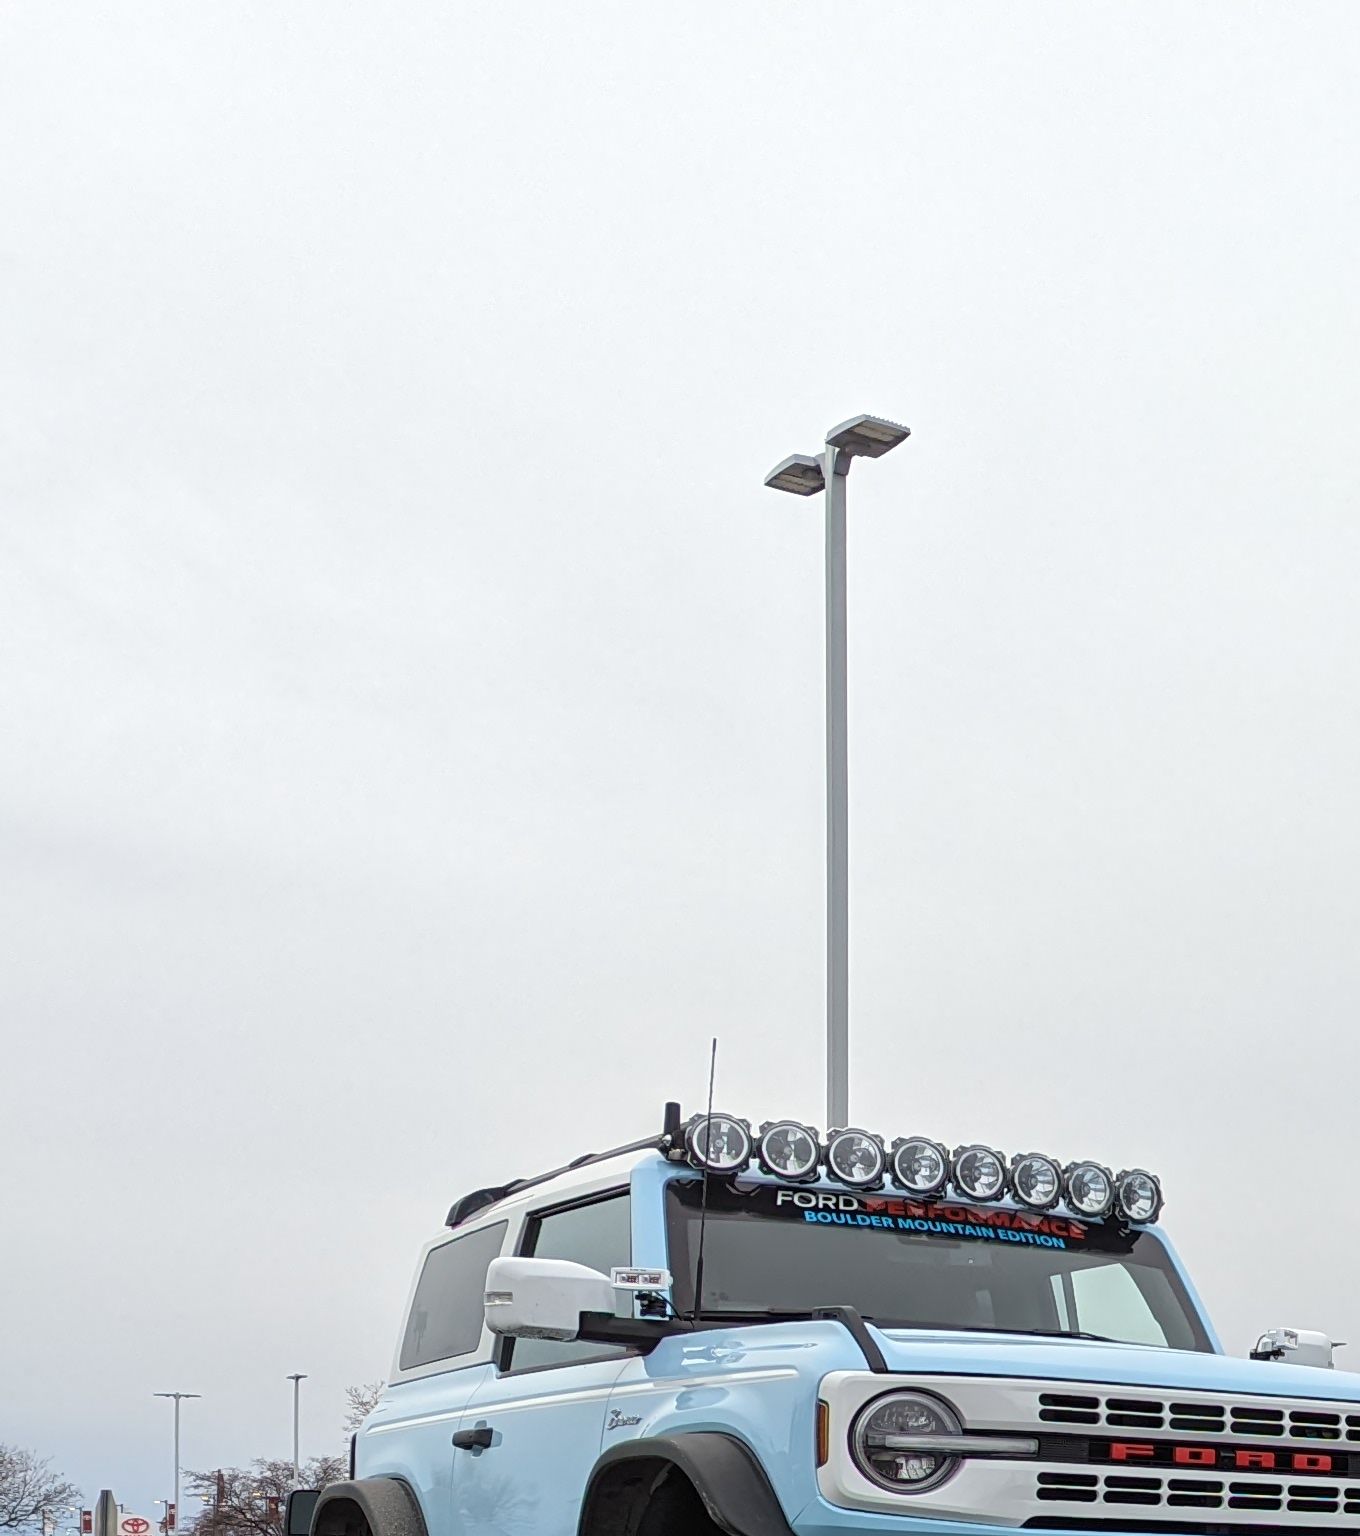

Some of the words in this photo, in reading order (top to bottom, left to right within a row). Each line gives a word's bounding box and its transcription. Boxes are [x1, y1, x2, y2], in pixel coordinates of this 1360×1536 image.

[776, 1190, 859, 1211] FORD
[804, 1210, 894, 1229] BOULDER
[897, 1218, 995, 1239] MOUNTAIN
[999, 1229, 1066, 1249] EDITION
[1110, 1442, 1332, 1471] FORD
